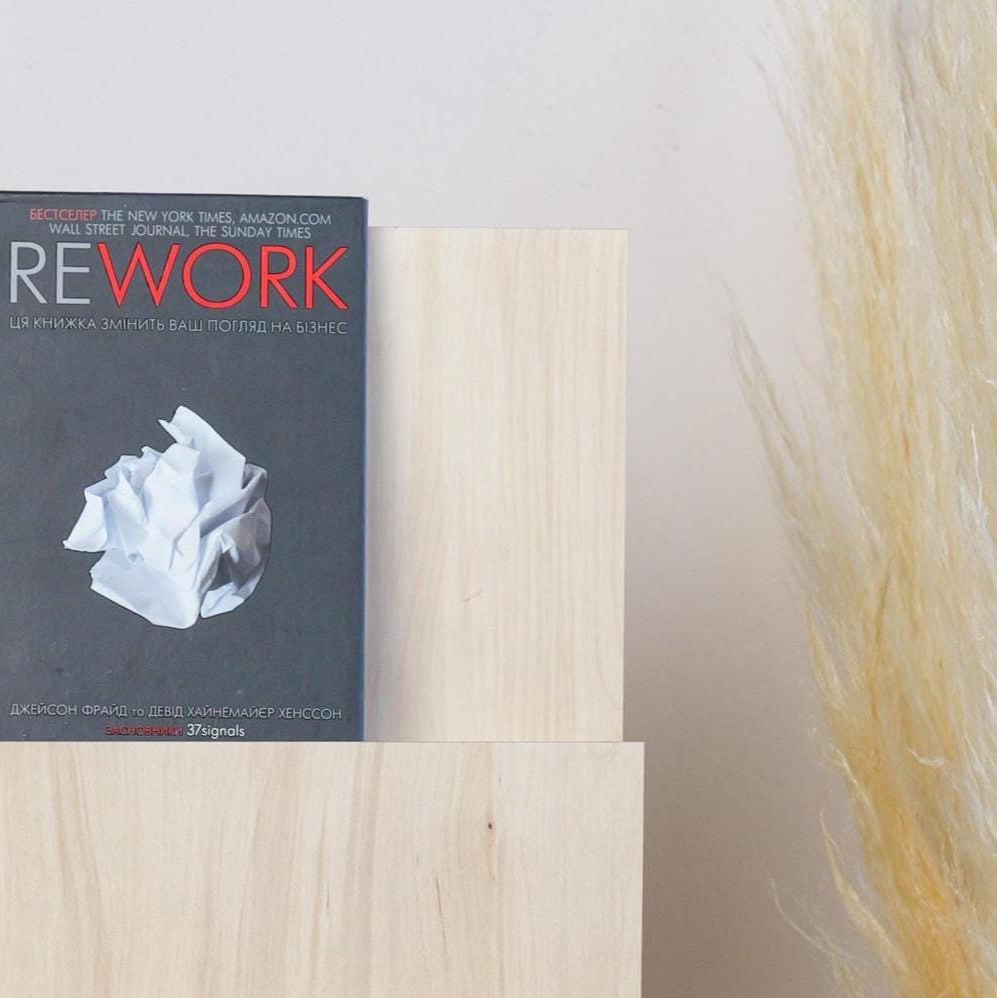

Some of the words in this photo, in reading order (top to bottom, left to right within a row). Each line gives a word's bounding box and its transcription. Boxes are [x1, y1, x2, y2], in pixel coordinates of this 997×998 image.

[29, 208, 98, 221] БЕСТСЕЛЕР
[101, 209, 123, 222] THE
[127, 210, 158, 222] NEW
[161, 210, 194, 223] YORK
[198, 211, 235, 225] TIMES,
[239, 212, 332, 225] AMAZON.COM
[49, 223, 81, 235] WALL
[85, 223, 126, 236] STREET
[130, 223, 190, 238] JOURNAL,
[194, 225, 216, 238] THE
[221, 226, 272, 238] SUNDAY
[277, 227, 312, 239] TIMES
[9, 241, 350, 309] REWORK
[9, 316, 29, 330] ЦЯ
[33, 317, 97, 330] КНИЖКА
[100, 317, 165, 331] ЗМІНИТЬ
[168, 318, 202, 332] ВАШ
[207, 319, 267, 334] ПОГЛЯД
[270, 320, 292, 333] НА
[296, 321, 348, 334] БІЗНЕС
[9, 702, 78, 716] ДЖЕЙСОН
[81, 703, 128, 717] ФРАЙД
[148, 705, 184, 718] ДЕВІД
[187, 704, 275, 719] ХАЙНЕМАЙЄР
[278, 707, 342, 720] ХЕНССОН
[186, 723, 246, 739] 37signals
